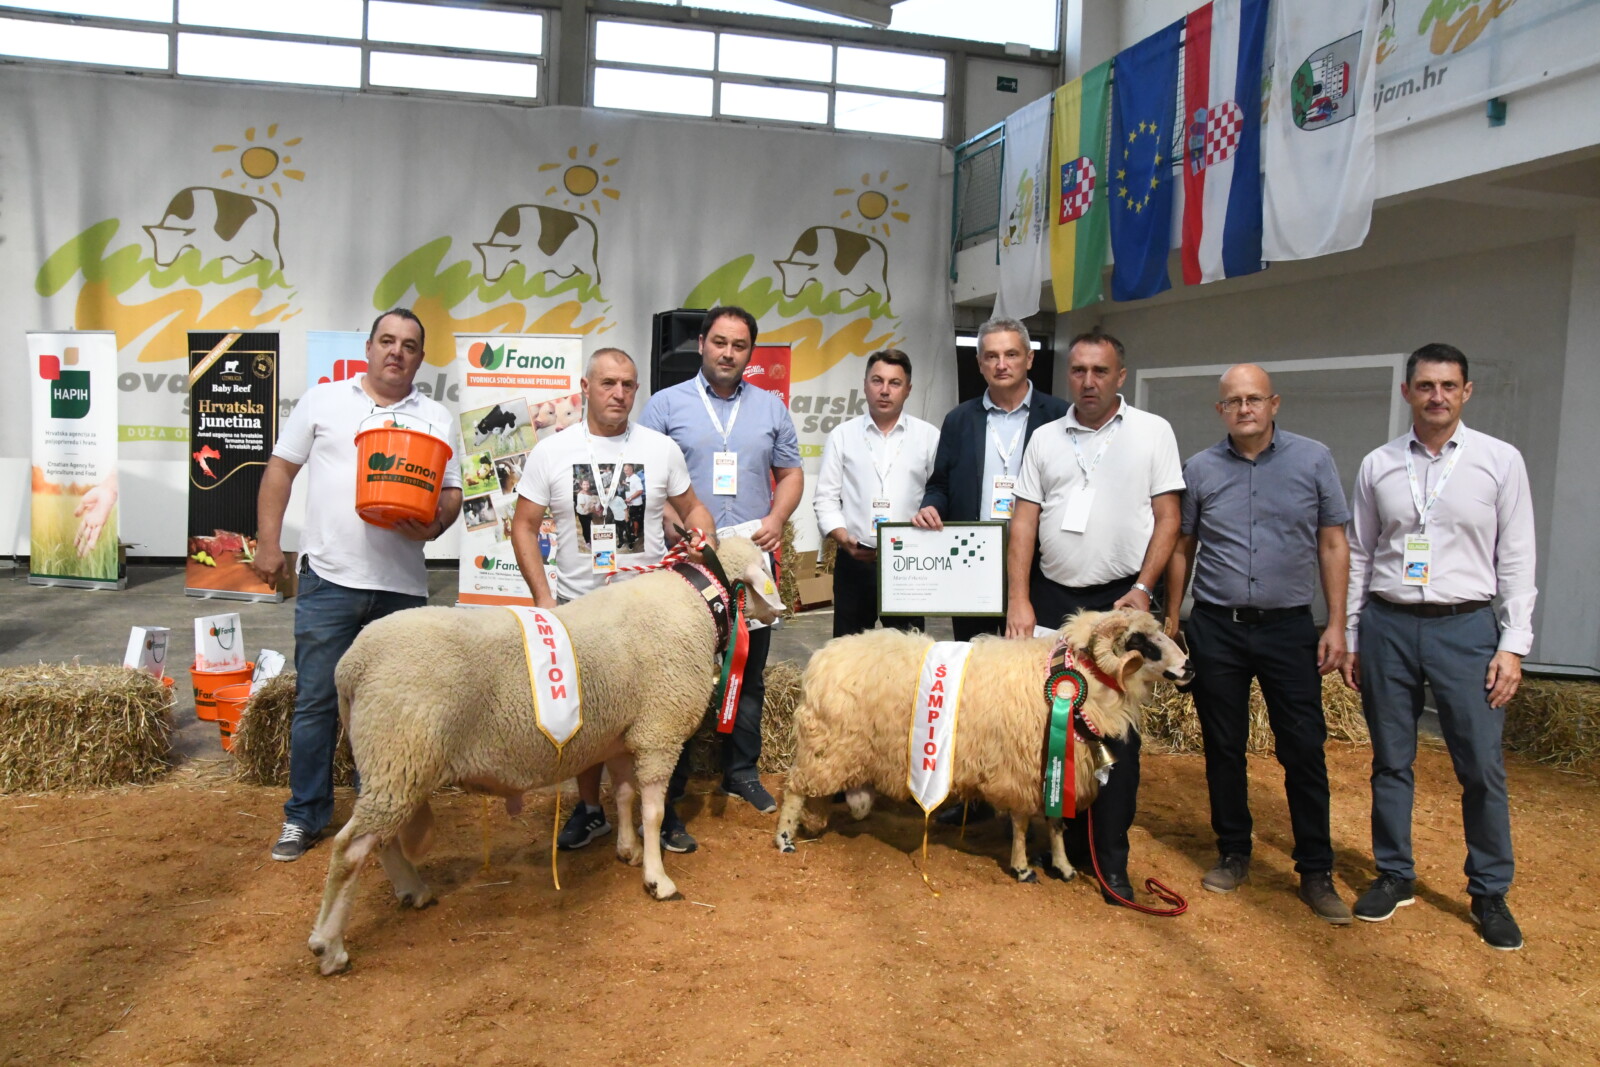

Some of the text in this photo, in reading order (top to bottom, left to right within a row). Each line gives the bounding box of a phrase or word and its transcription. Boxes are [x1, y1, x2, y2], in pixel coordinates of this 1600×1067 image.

[1374, 65, 1448, 112] jam.hr
[505, 349, 565, 369] Fanon
[212, 384, 252, 394] Baby Beef
[497, 376, 516, 384] STOČNE
[517, 377, 535, 385] HRANE
[54, 388, 88, 400] HAPIH
[198, 400, 264, 414] Hrvatska
[199, 413, 261, 431] junetina
[128, 426, 166, 439] DUŽA
[396, 457, 436, 480] Fanon
[893, 555, 952, 572] DIPLOMA
[922, 664, 947, 771] ŠAMPION
